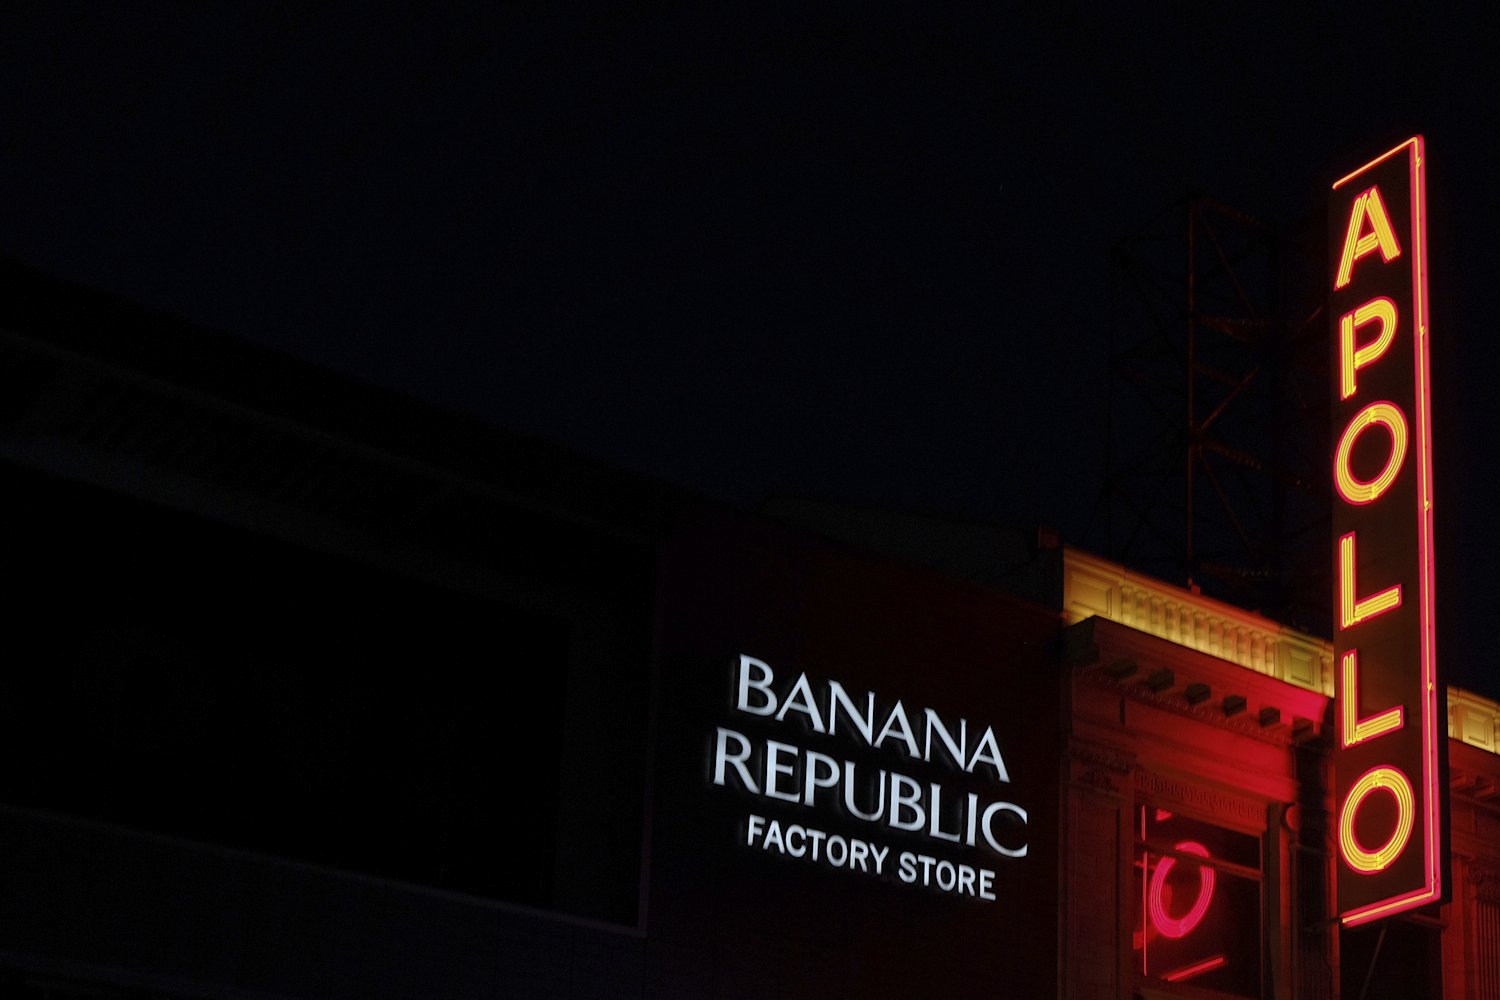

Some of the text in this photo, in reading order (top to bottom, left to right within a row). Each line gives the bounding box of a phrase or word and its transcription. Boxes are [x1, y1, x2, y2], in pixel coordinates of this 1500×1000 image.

[1334, 186, 1415, 874] APOLLO
[736, 653, 1011, 783] BANANA
[713, 726, 1028, 858] REPUBLIC
[747, 814, 996, 901] FACTORY STORE
